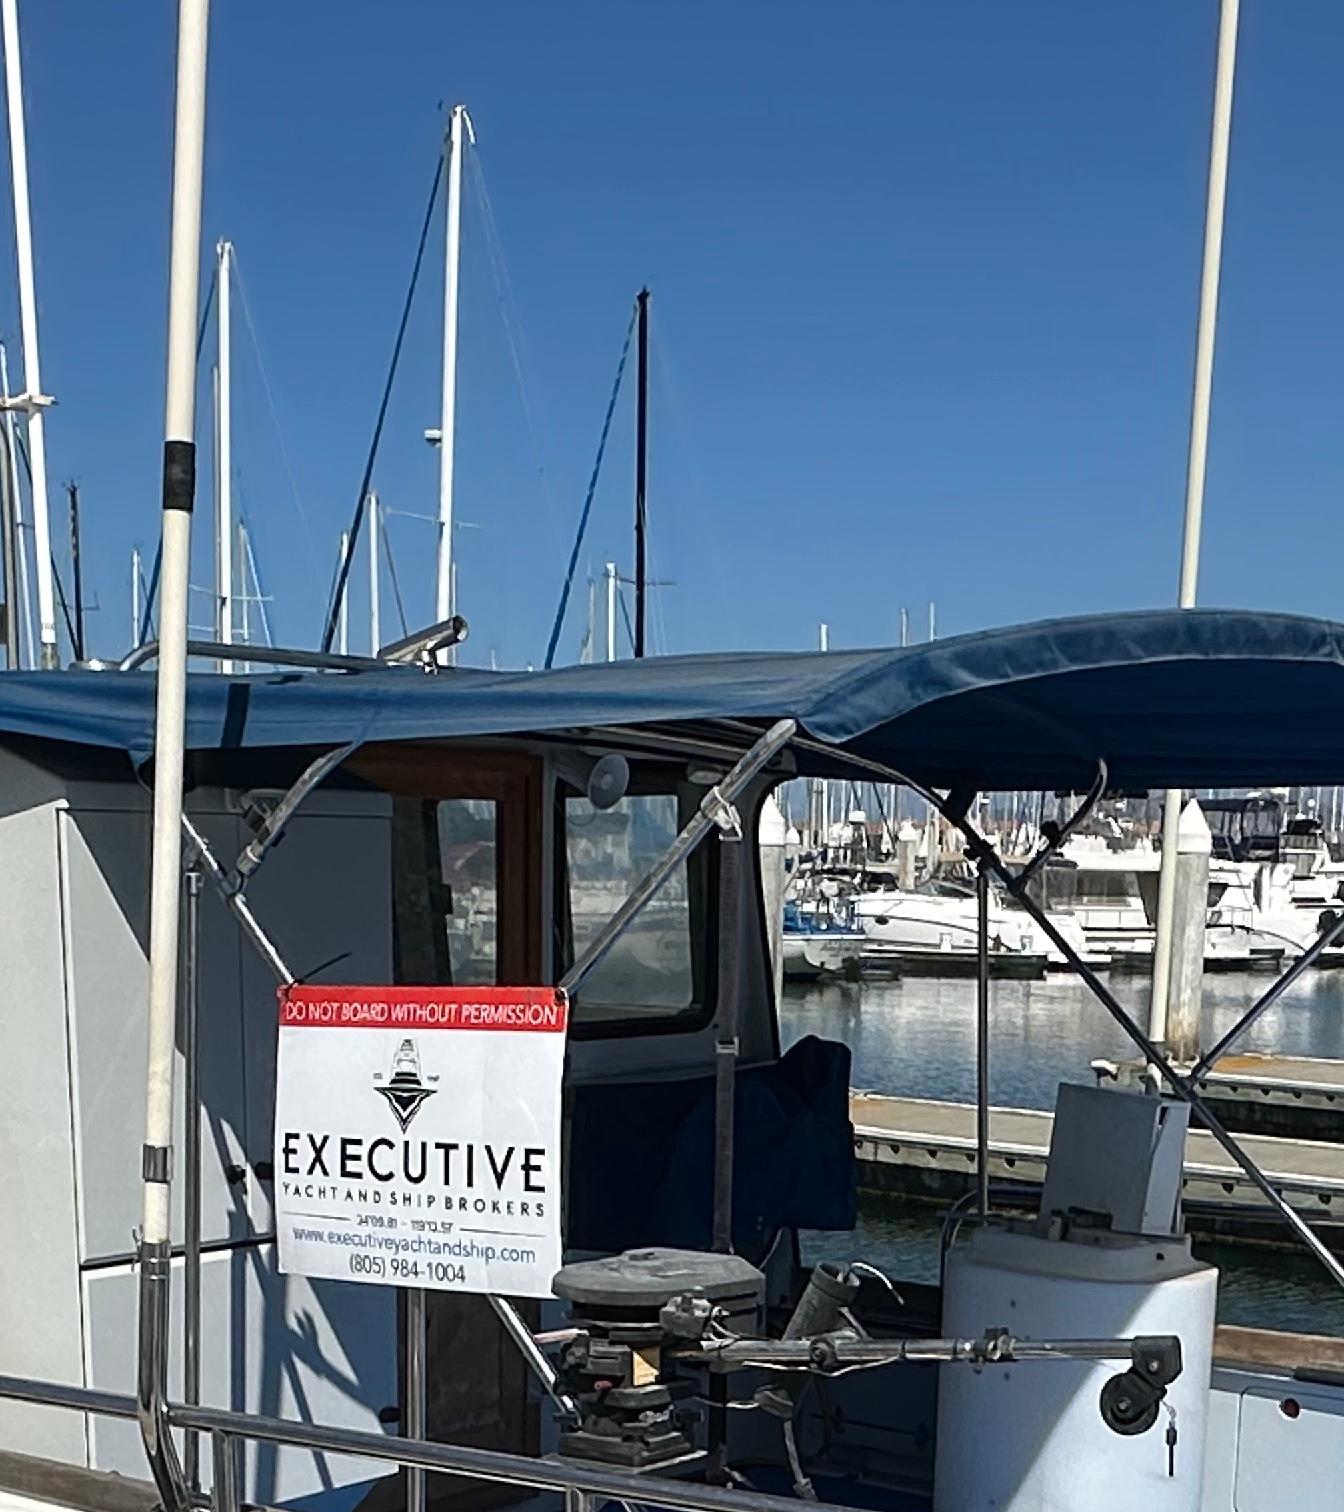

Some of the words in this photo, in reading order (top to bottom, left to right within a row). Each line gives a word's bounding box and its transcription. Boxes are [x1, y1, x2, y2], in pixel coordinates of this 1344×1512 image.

[285, 1001, 306, 1020] DO
[308, 1001, 340, 1021] NOT
[341, 1002, 388, 1022] BOARD
[390, 1003, 458, 1023] WITHOUT
[460, 1004, 557, 1026] PERMISSION
[282, 1132, 546, 1194] EXECUTIVE
[282, 1181, 338, 1200] YACHT
[343, 1188, 382, 1204] AND
[388, 1190, 436, 1208] SHIP
[444, 1195, 544, 1217] BROKERS
[292, 1227, 536, 1266] www.executiveyachtandship.com
[349, 1253, 386, 1278] (805)
[389, 1258, 466, 1283] 984-1004
